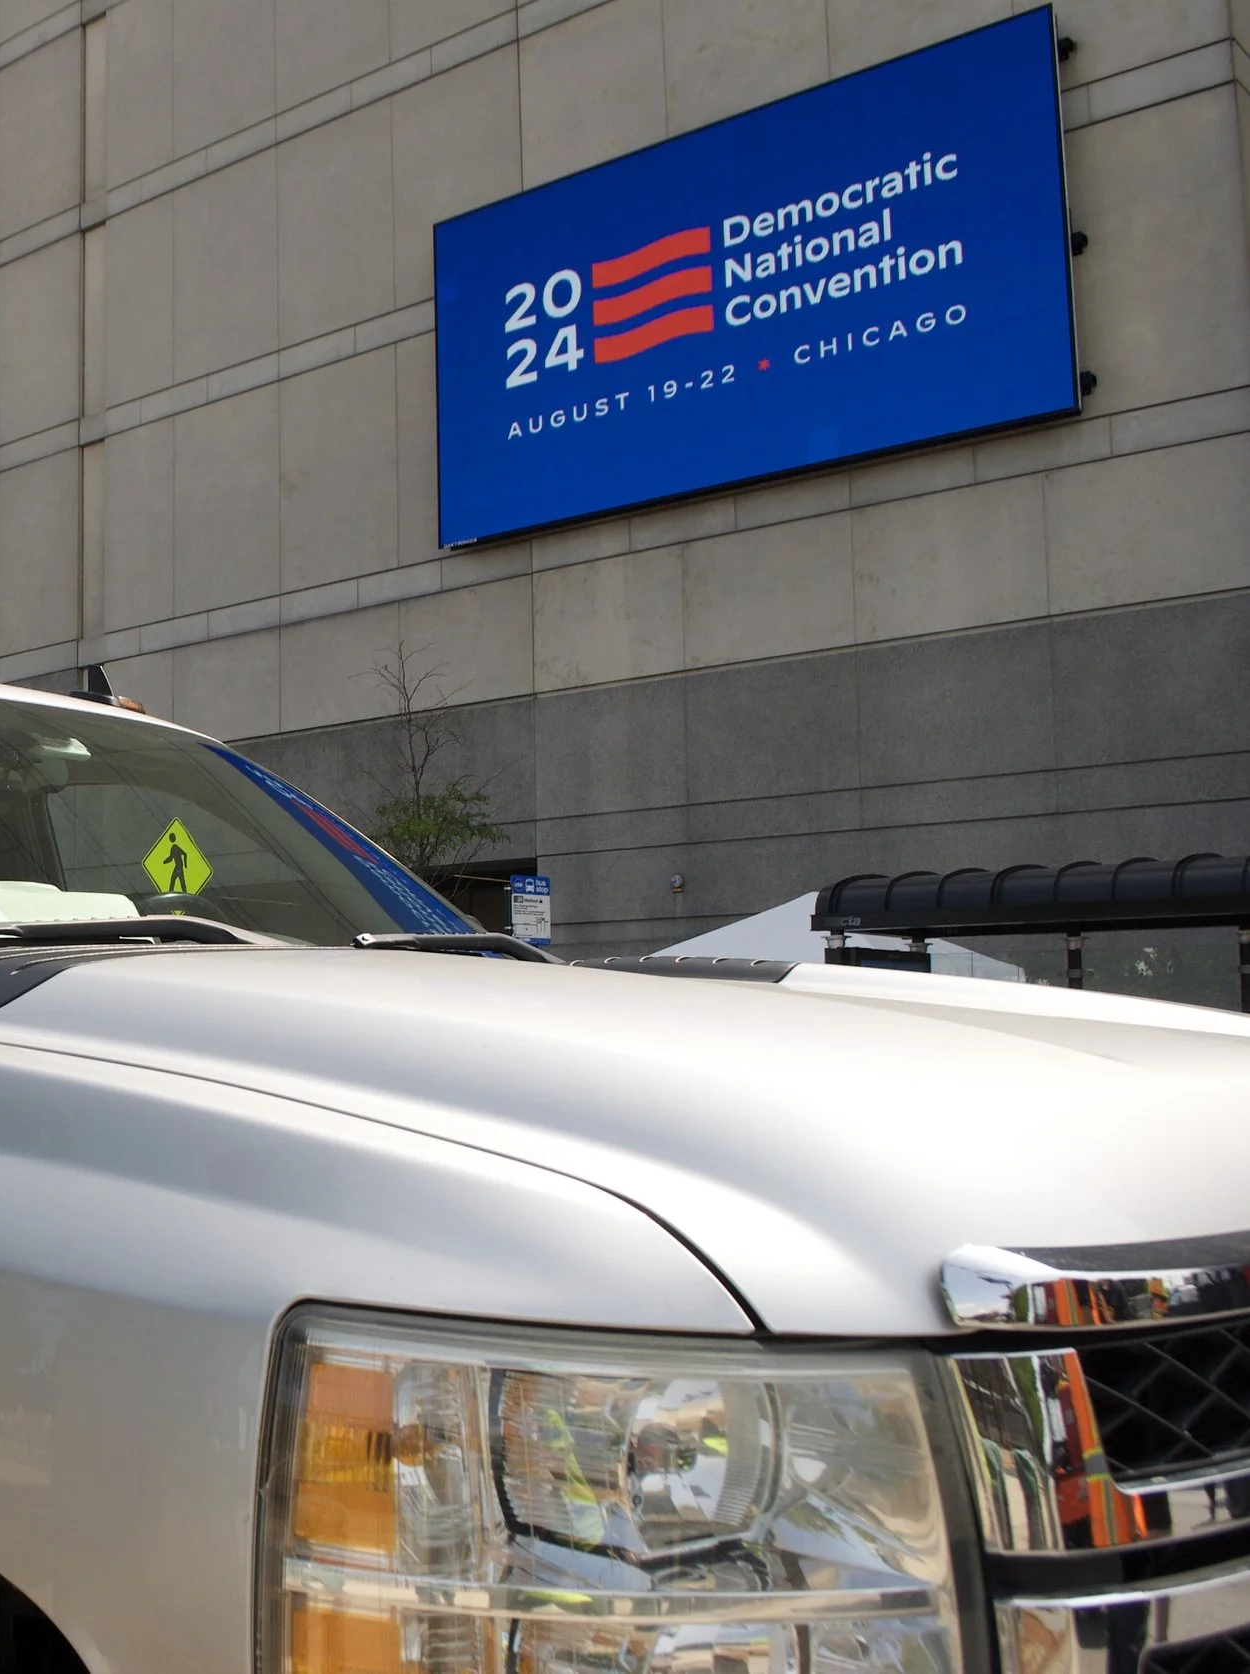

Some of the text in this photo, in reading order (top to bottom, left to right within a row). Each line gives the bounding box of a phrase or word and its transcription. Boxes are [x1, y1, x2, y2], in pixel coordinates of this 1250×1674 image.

[721, 152, 959, 248] Democratic
[724, 208, 892, 287] National
[725, 239, 963, 326] Convention
[504, 268, 582, 333] 20
[505, 324, 585, 389] 24
[507, 304, 968, 440] AUGUST 19-22 CHICAGO
[535, 879, 546, 887] bus
[535, 886, 549, 894] stop
